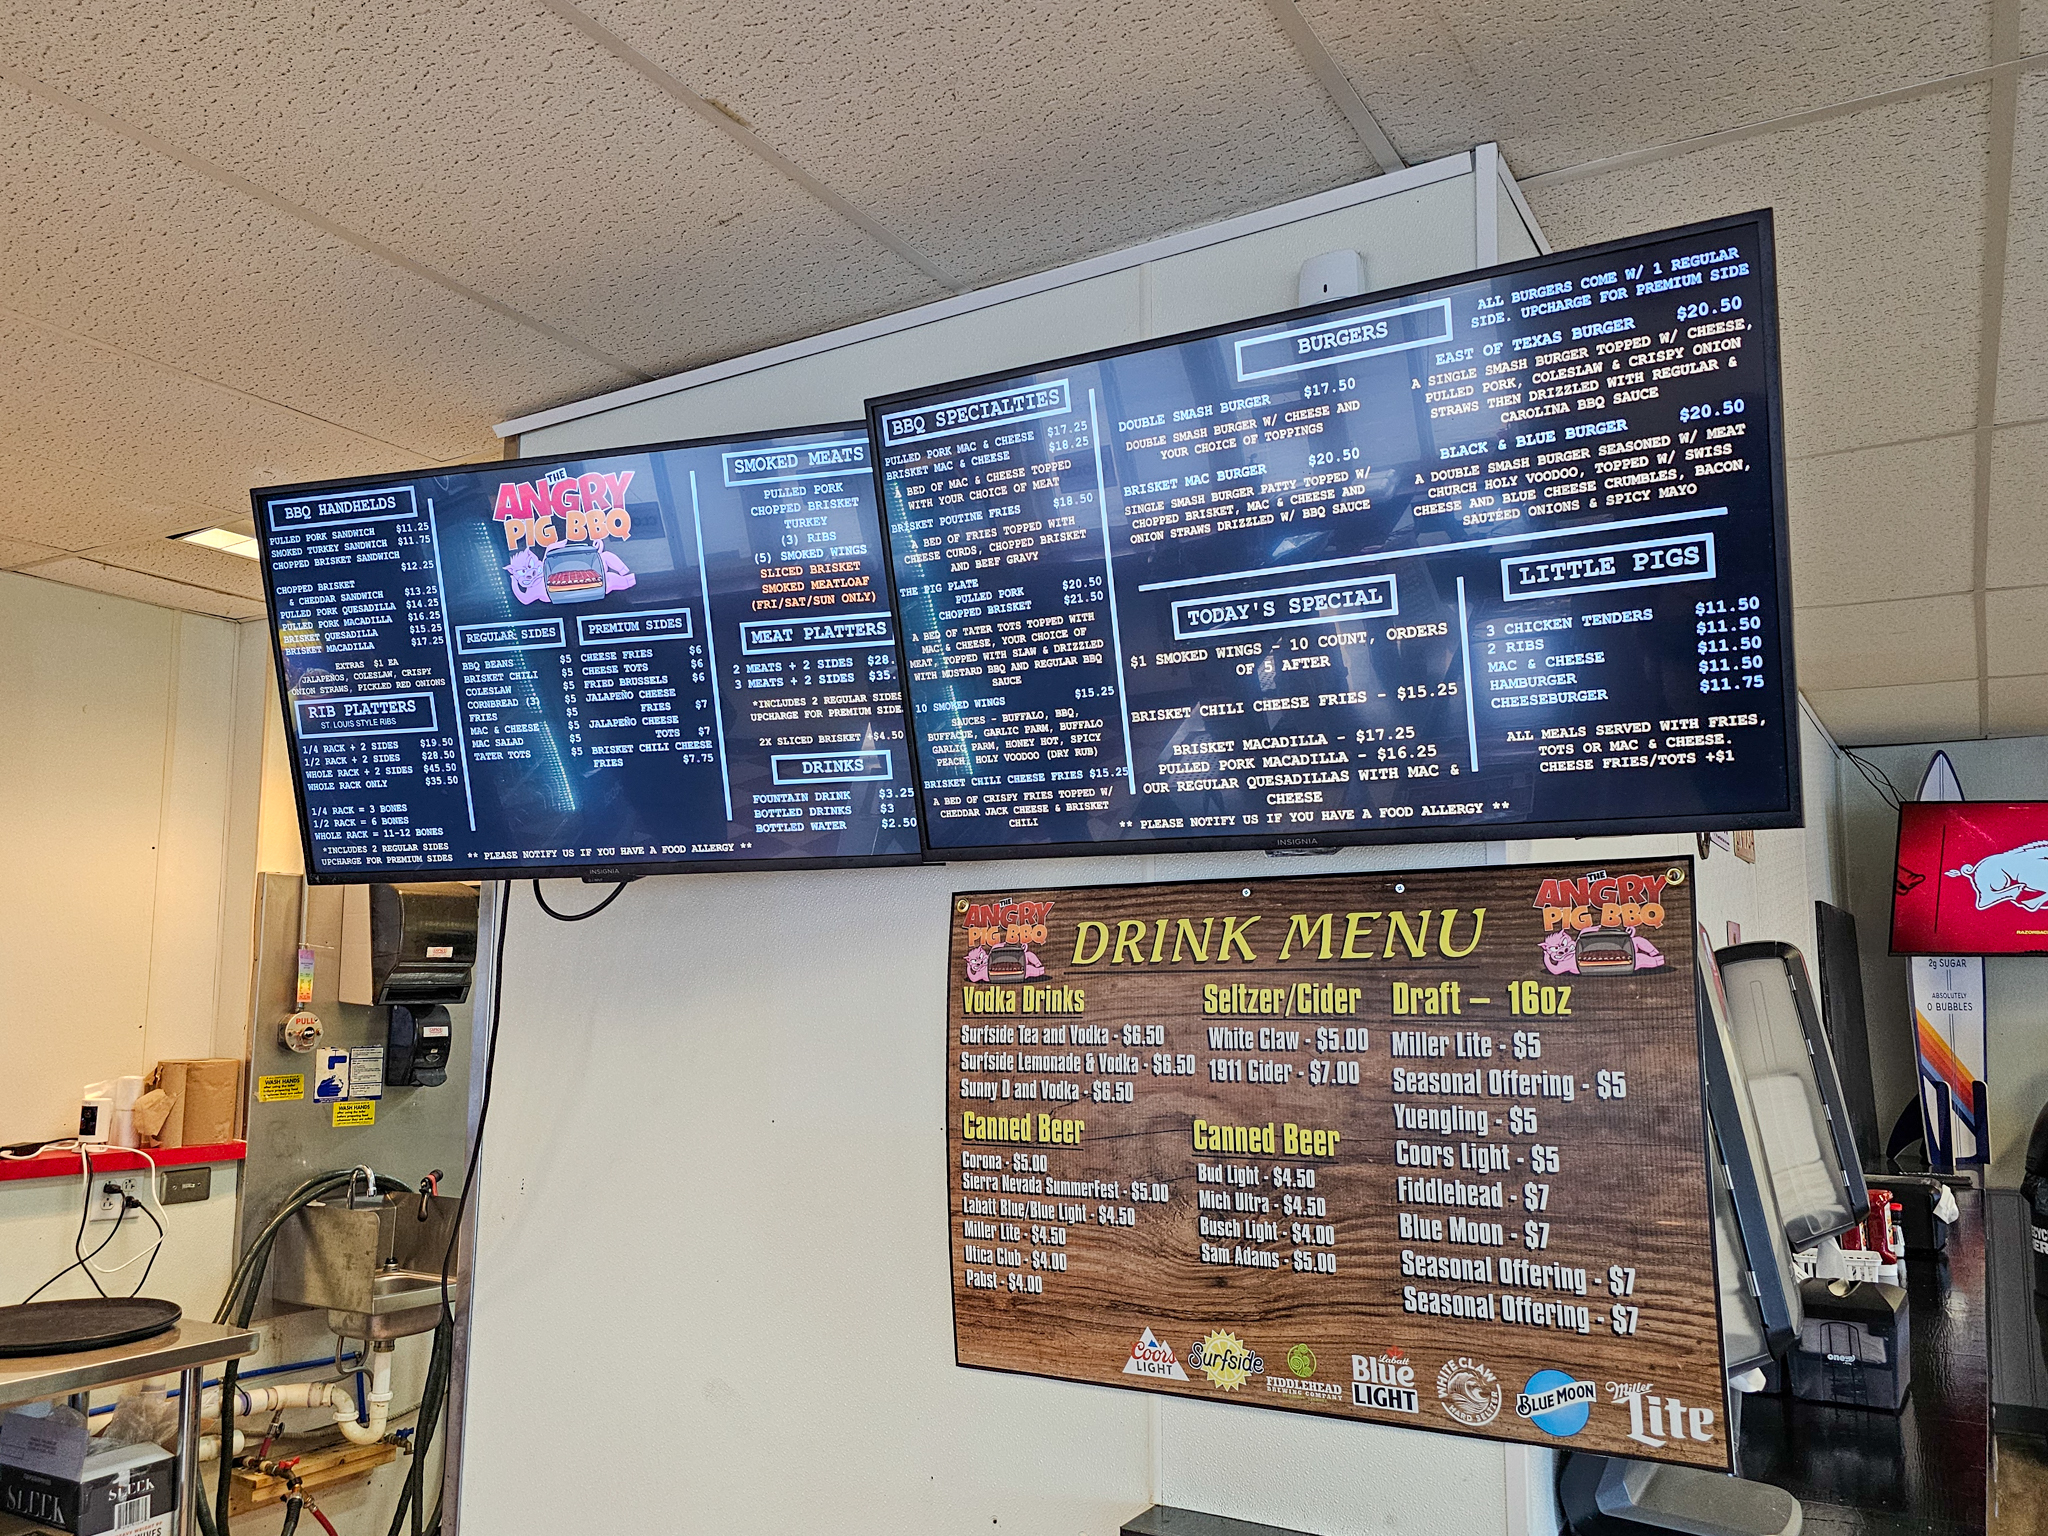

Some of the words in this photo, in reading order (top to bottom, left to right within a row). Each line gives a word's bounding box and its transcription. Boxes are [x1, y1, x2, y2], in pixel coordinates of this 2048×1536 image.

[1297, 321, 1388, 354] BURGERS
[1435, 347, 1475, 367] EAST
[1482, 342, 1504, 358] OF
[1511, 331, 1562, 351] TEXAS
[1571, 317, 1635, 340] BURGER
[1677, 296, 1742, 322] $20.50
[892, 416, 926, 435] BBQ
[935, 388, 1060, 427] SPECIALTIES
[1118, 414, 1165, 432] DOUBLE
[1173, 405, 1213, 422] SMASH
[1220, 394, 1271, 413] BURGER
[1304, 377, 1356, 399] $17.50
[735, 454, 799, 473] SMOKED
[808, 447, 864, 466] MEATS
[547, 470, 566, 482] THE
[493, 471, 635, 522] ANGRY
[763, 486, 807, 499] PULLED
[814, 483, 843, 494] PORK
[284, 505, 312, 519] BBQ
[318, 496, 396, 516] HANDHELDS
[269, 535, 301, 545] PULLED
[305, 532, 328, 542] PORK
[332, 527, 375, 539] SANDWICH
[396, 522, 429, 534] $11.25
[504, 515, 558, 551] PIG
[566, 508, 631, 541] BBQ
[784, 516, 828, 529] TURKEY
[760, 566, 803, 578] SLICED
[809, 561, 861, 574] BRISKET
[1519, 557, 1616, 585] LITTLE
[1632, 546, 1700, 571] PIGS
[1188, 601, 1275, 625] TODAY'S
[1289, 588, 1383, 613] SPECIAL
[1486, 624, 1496, 637] 3
[1504, 617, 1573, 635] CHICKEN
[1581, 608, 1653, 627] TENDERS
[1695, 596, 1760, 617] $11.50
[466, 629, 518, 643] REGULAR
[521, 627, 556, 639] SIDES
[588, 621, 640, 634] PREMIUM
[646, 618, 683, 630] SIDES
[751, 628, 793, 644] MEAT
[803, 621, 887, 640] PLATTERS
[1488, 643, 1496, 654] 2
[1505, 639, 1544, 653] RIBS
[1696, 616, 1761, 636] $11.50
[580, 652, 617, 662] CHEESE
[622, 649, 653, 659] FRIES
[689, 645, 702, 656] $6
[1490, 673, 1577, 691] HAMBURGER
[1699, 655, 1763, 674] $11.50
[1491, 689, 1608, 709] CHEESEBURGER
[1700, 674, 1764, 694] $11.75
[308, 705, 336, 718] RIB
[344, 700, 416, 716] PLATTERS
[321, 720, 331, 729] ST.
[333, 720, 354, 729] LOUIS
[356, 718, 379, 727] STYLE
[380, 717, 397, 726] RIBS
[474, 752, 504, 761] TATER
[507, 750, 532, 759] TOTS
[571, 747, 583, 757] $5
[802, 757, 864, 774] DRINKS
[1540, 759, 1594, 772] CHEESE
[1602, 752, 1696, 769] FRIES/TOTS
[1705, 749, 1735, 763] +$1
[752, 792, 808, 804] FOUNTAIN
[814, 791, 851, 801] DRINK
[879, 788, 914, 800] $3.25
[755, 822, 805, 833] BOTTLED
[810, 821, 847, 831] WATER
[881, 817, 917, 829] $2.50
[1588, 871, 1605, 881] THE
[1533, 874, 1668, 909] ANGRY
[962, 901, 1055, 930] ANGRY
[1543, 905, 1593, 931] PIG
[1601, 902, 1665, 929] BBQ
[969, 926, 1000, 947] PIG
[1006, 924, 1046, 945] BBQ
[1072, 916, 1261, 964] DRINK
[1279, 908, 1486, 959] MENU
[1928, 959, 1937, 969] 2g
[1939, 959, 1967, 967] SUGAR
[964, 986, 1016, 1012] Vodka
[1023, 985, 1085, 1012] Drinks
[1203, 983, 1361, 1017] Seltzer/Cider
[1393, 981, 1461, 1014] Draft
[1508, 981, 1572, 1014] 16oz
[1927, 1003, 1932, 1011] 0
[1936, 1003, 1973, 1011] BUBBLES
[962, 1025, 1014, 1043] Surfside
[1018, 1025, 1039, 1043] Tea
[1043, 1025, 1066, 1044] and
[1070, 1025, 1109, 1044] Vodka
[1123, 1023, 1164, 1045] $6.50
[1209, 1027, 1254, 1049] White
[1260, 1027, 1299, 1050] Claw
[1317, 1026, 1369, 1051] $5.00
[1392, 1031, 1450, 1056] Miller
[1457, 1032, 1492, 1057] Lite
[1514, 1030, 1541, 1060] $5
[963, 1111, 1031, 1142] Canned
[1038, 1113, 1085, 1144] Beer
[1394, 1103, 1488, 1136] Yuengling
[1510, 1105, 1537, 1134] $5
[1194, 1119, 1275, 1153] Canned
[1284, 1123, 1340, 1156] Beer
[1198, 1163, 1223, 1183] Bud
[1227, 1165, 1260, 1187] Light
[1273, 1166, 1315, 1188] $4.50
[965, 1245, 993, 1263] Utica
[997, 1247, 1021, 1266] Club
[1032, 1249, 1067, 1270] $4.00
[1131, 1341, 1176, 1364] Coors
[1189, 1342, 1264, 1374] Surfside
[1379, 1354, 1409, 1365] Labatt
[1136, 1361, 1173, 1375] LIGHT
[1351, 1354, 1414, 1387] Blue
[1437, 1360, 1458, 1398] WHITE
[1459, 1357, 1497, 1382] CLAW
[1266, 1376, 1342, 1395] FIDDLEHEAD
[1267, 1386, 1302, 1395] BREWING
[1305, 1391, 1343, 1400] COMPANY
[1354, 1384, 1415, 1410] LIGHT
[1605, 1381, 1654, 1400] Miller
[1449, 1405, 1473, 1421] HARD
[1476, 1391, 1498, 1421] SELTZER
[1517, 1393, 1555, 1415] BLUE
[1556, 1384, 1594, 1404] MOON
[1612, 1393, 1714, 1447] Lite
[7, 1485, 65, 1525] SLEEK
